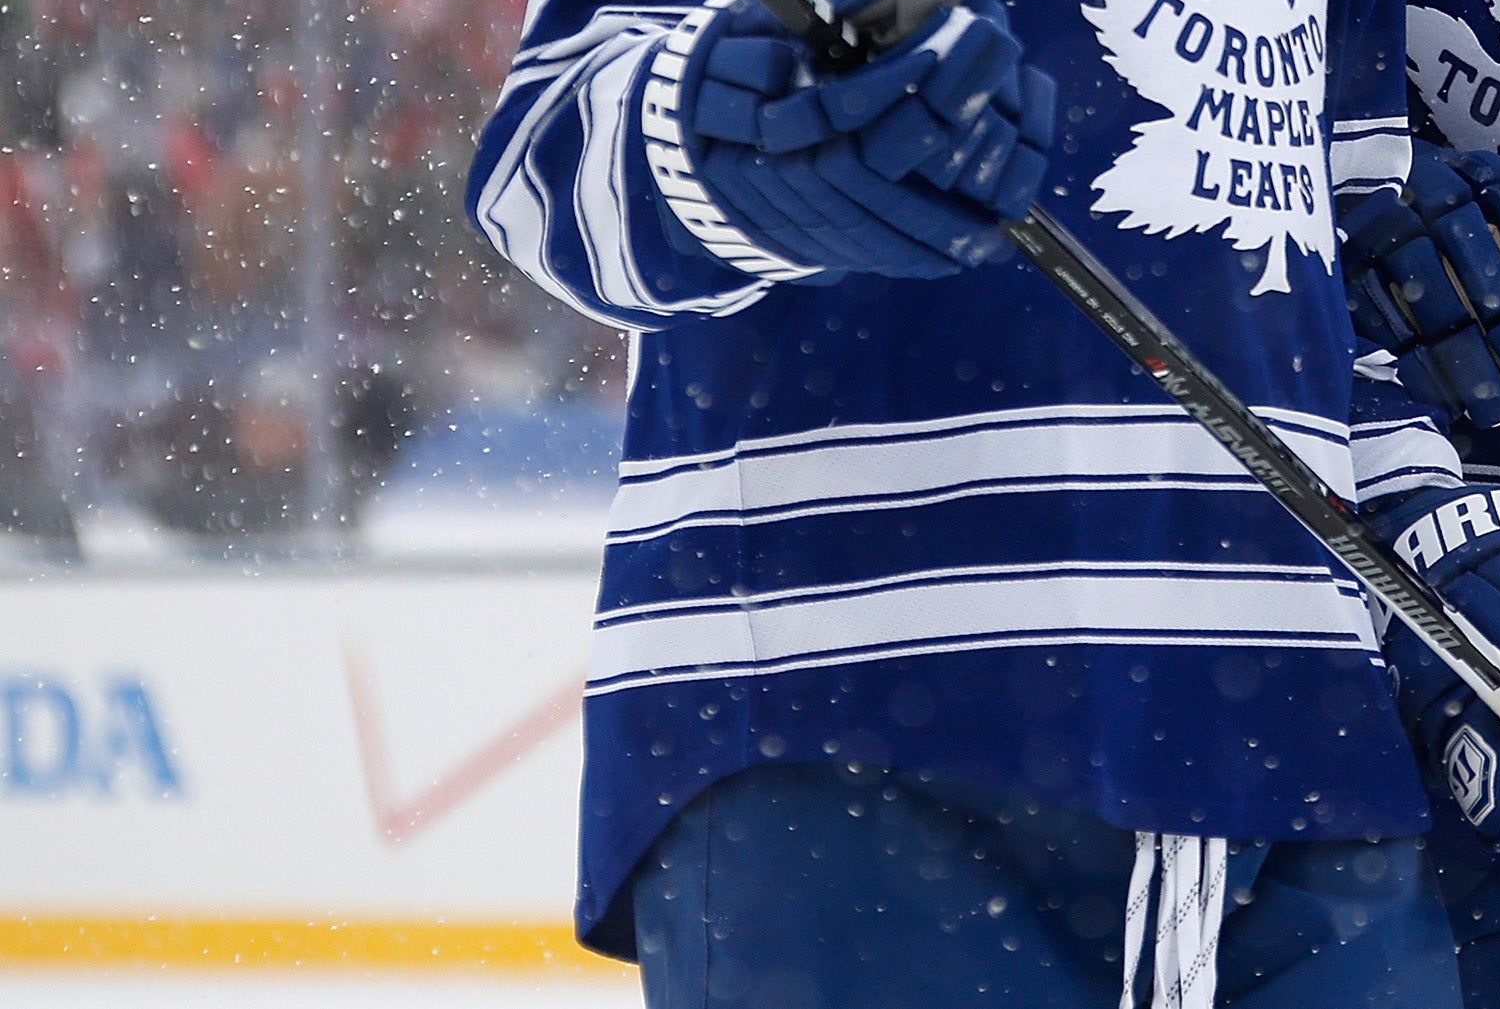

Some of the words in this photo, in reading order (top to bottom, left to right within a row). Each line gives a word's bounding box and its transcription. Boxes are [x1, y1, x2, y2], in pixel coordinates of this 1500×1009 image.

[1185, 83, 1315, 148] MAPLE
[1191, 149, 1315, 216] LEAFS
[1327, 534, 1461, 650] WARRIOR
